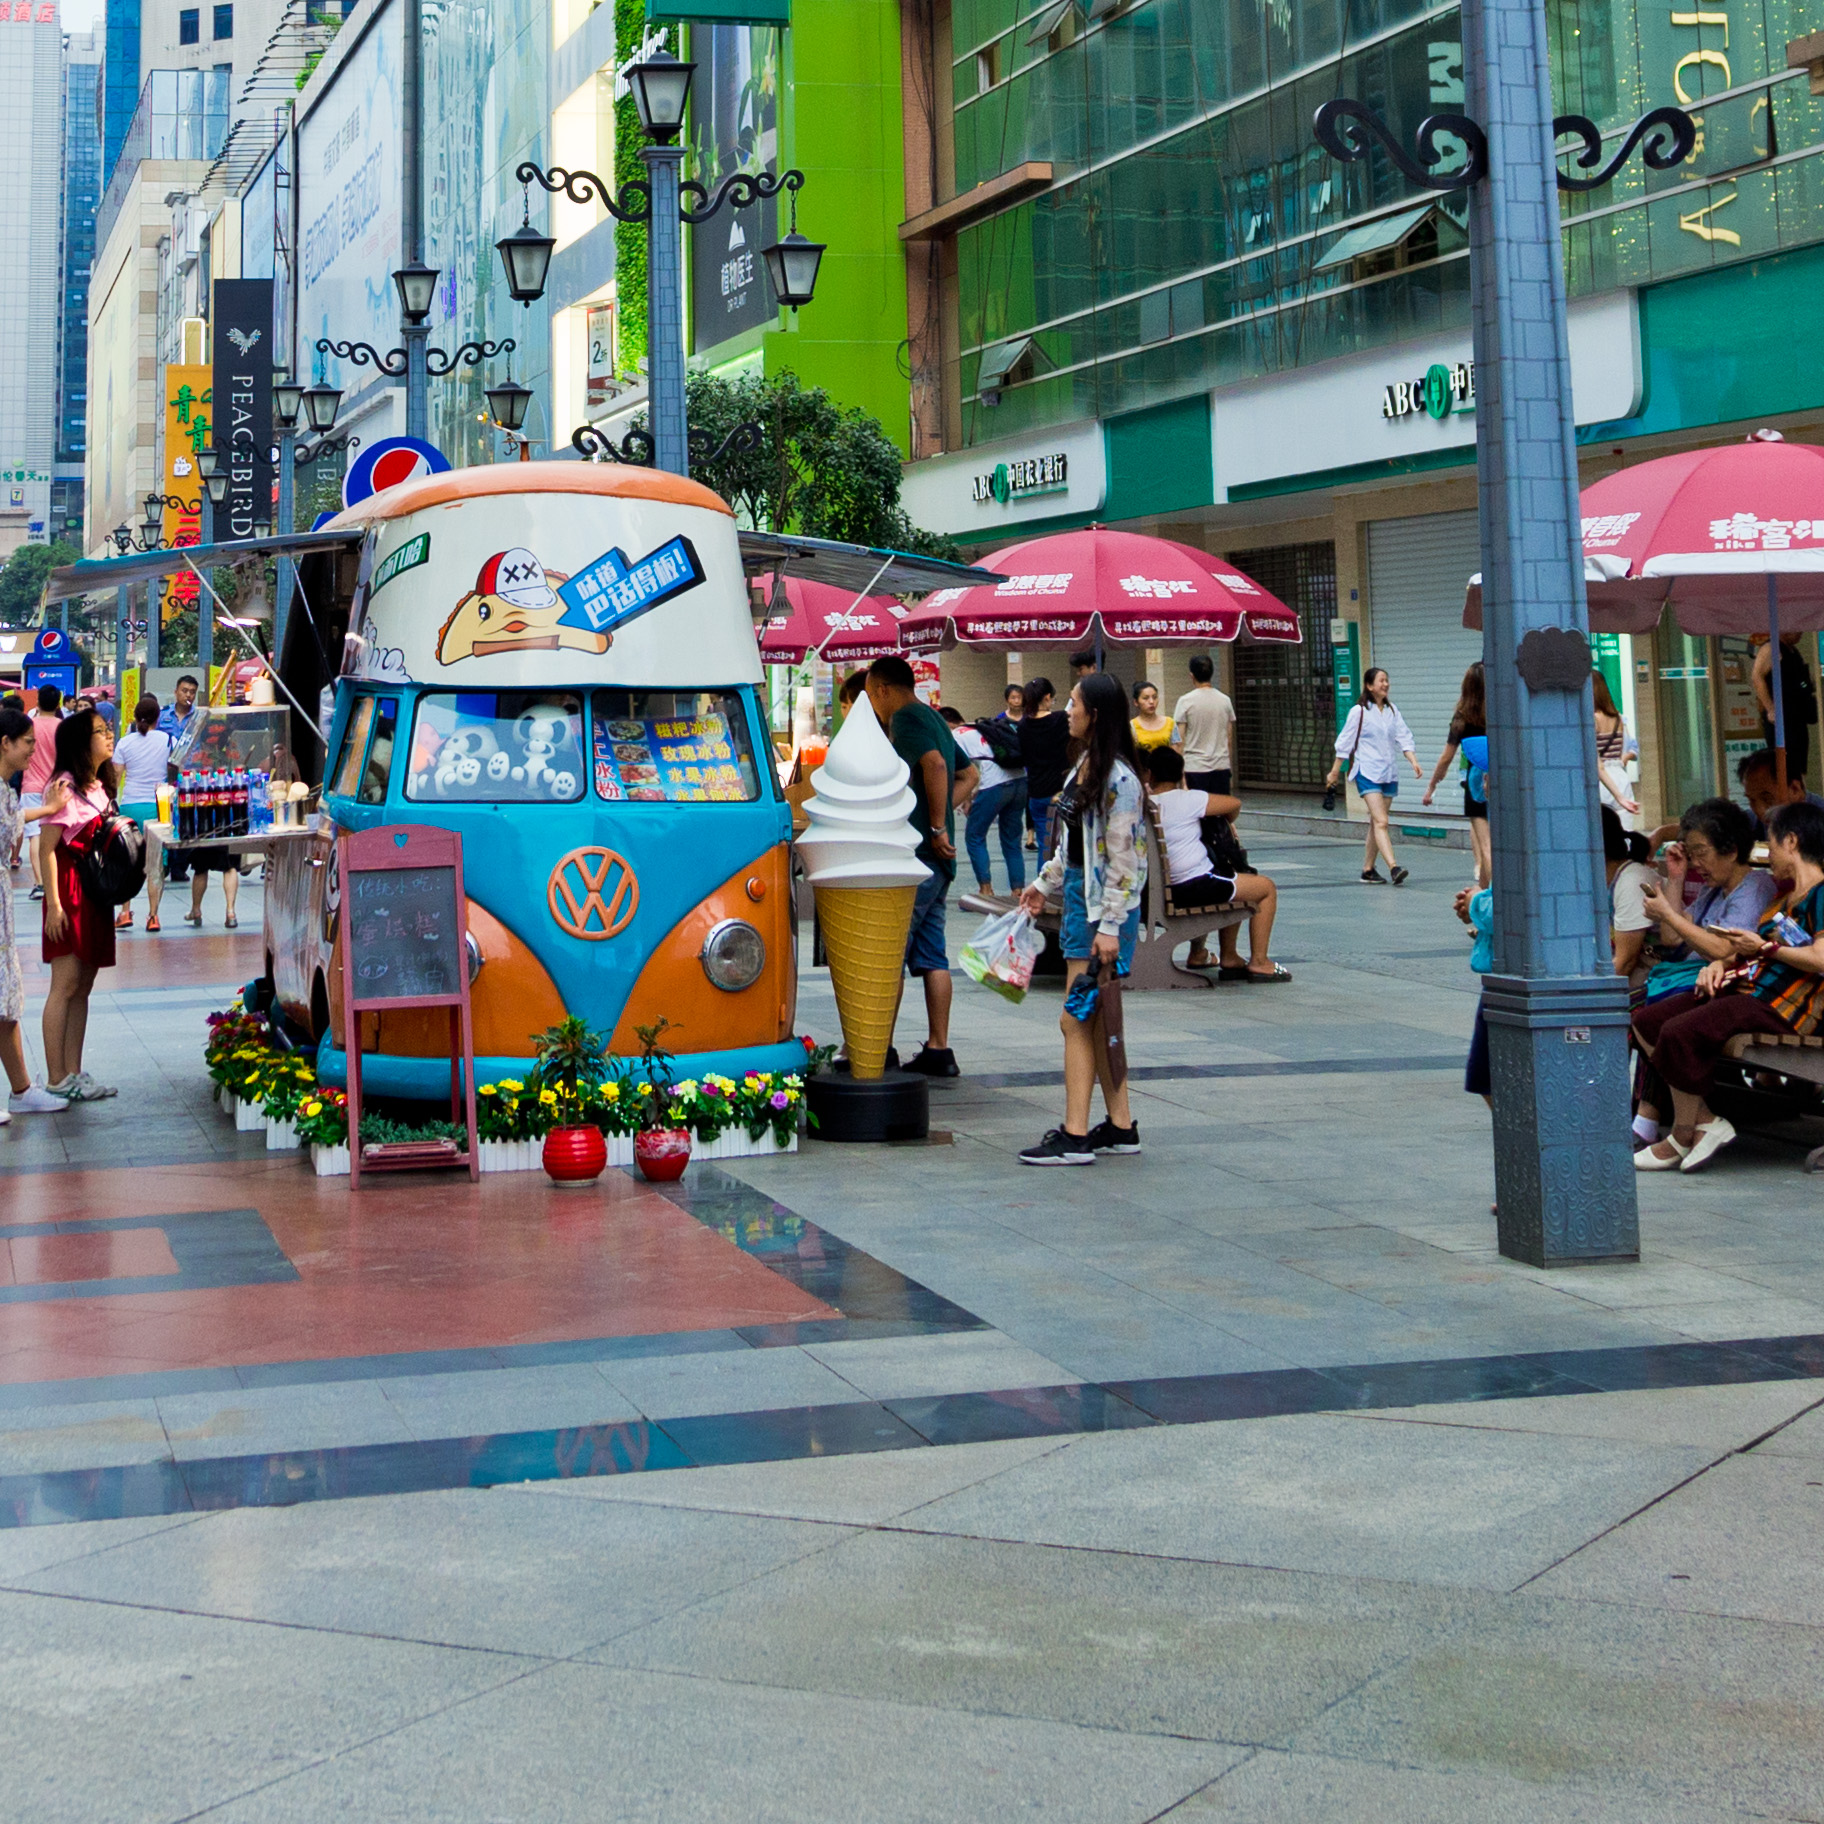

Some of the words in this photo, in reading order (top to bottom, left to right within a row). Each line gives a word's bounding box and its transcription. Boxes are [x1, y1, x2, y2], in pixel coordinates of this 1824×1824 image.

[1382, 379, 1422, 418] ABC
[231, 375, 254, 536] PEACEBIRD
[973, 473, 996, 501] ABC
[575, 561, 620, 600] 味道
